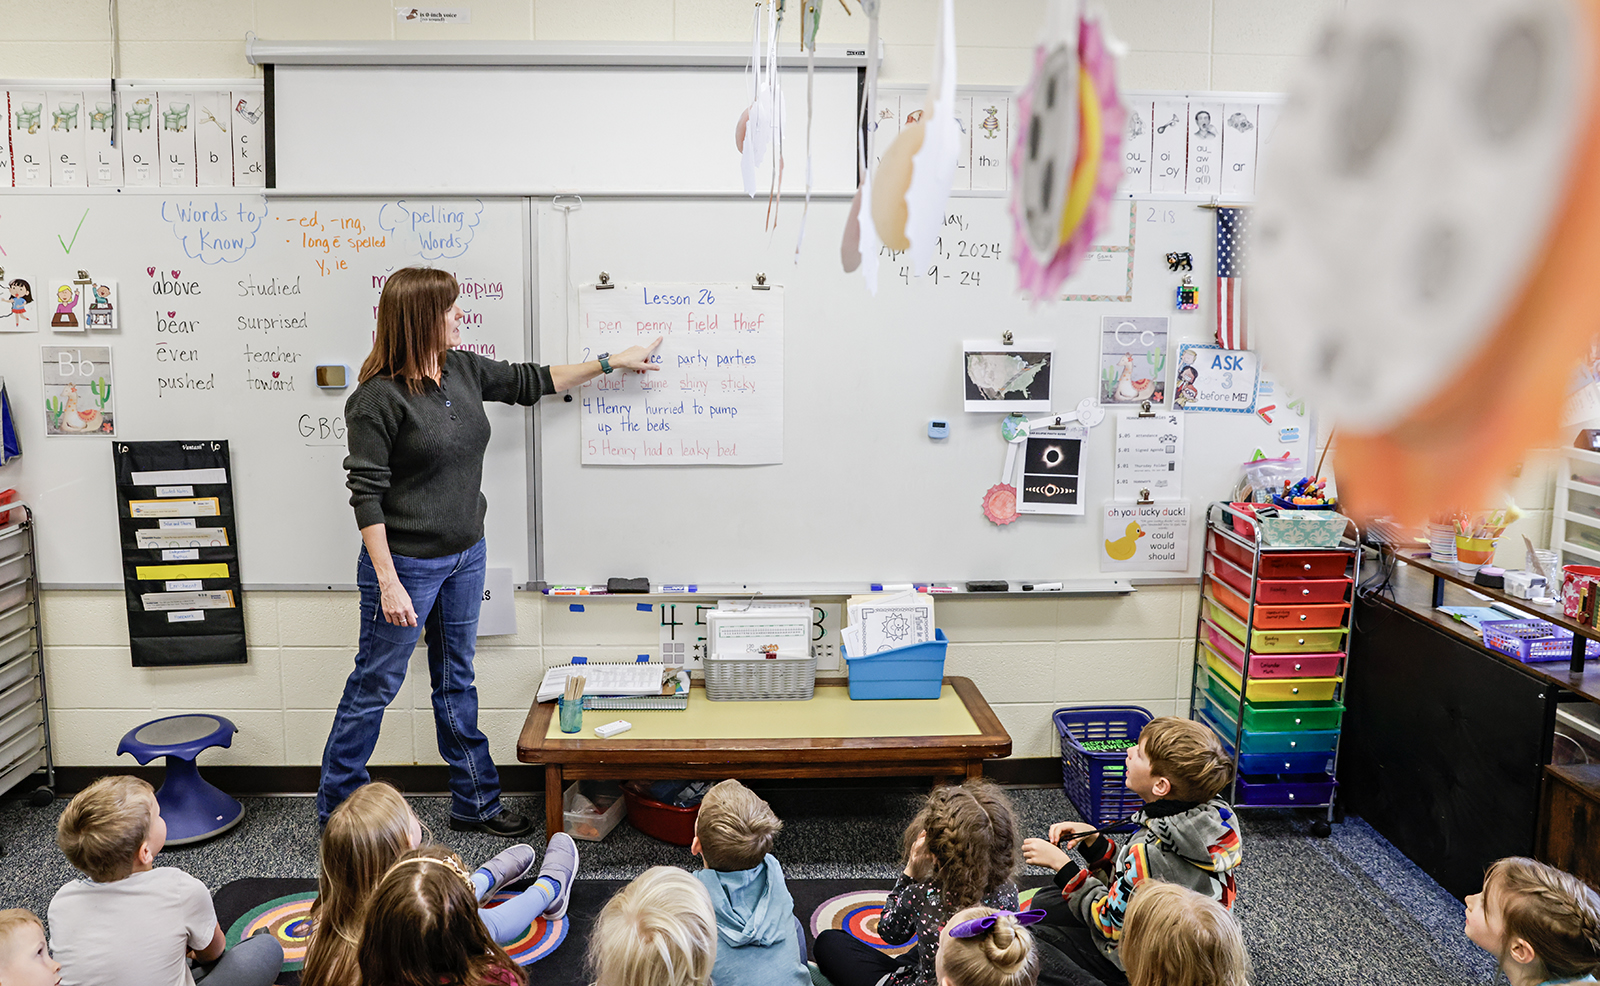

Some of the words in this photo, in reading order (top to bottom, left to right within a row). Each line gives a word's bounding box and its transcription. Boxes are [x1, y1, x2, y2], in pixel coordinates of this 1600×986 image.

[210, 151, 218, 163] b
[1160, 151, 1171, 161] oi
[1232, 163, 1246, 172] ar
[176, 202, 228, 223] Words
[237, 201, 257, 223] to
[393, 200, 465, 233] Spelling
[200, 231, 245, 250] Know
[302, 233, 329, 254] long
[347, 235, 386, 251] spelled
[419, 231, 463, 250] Words
[958, 240, 1001, 260] 2024
[335, 258, 349, 270] ie
[153, 271, 201, 296] above
[644, 287, 690, 305] Lesson
[698, 288, 715, 305] 26
[156, 311, 200, 334] bear
[237, 312, 308, 333] surprised
[599, 319, 622, 333] pen
[636, 320, 673, 336] penny
[687, 311, 719, 331] field
[733, 313, 765, 331] thief
[1115, 321, 1155, 347] Cc
[58, 350, 95, 377] Bb
[244, 343, 302, 365] teacher
[677, 348, 709, 367] party
[716, 348, 757, 368] parties
[1211, 354, 1244, 372] ASK
[158, 373, 215, 394] pushed
[246, 371, 295, 392] toward
[597, 372, 628, 389] chief
[640, 373, 669, 389] shine
[680, 373, 709, 394] shiny
[721, 374, 756, 394] sticky
[1221, 372, 1234, 389] 3
[1200, 390, 1230, 402] before
[1232, 392, 1248, 403] ME!
[583, 397, 592, 414] 4
[596, 396, 632, 419] Henry
[645, 398, 684, 415] hurried
[692, 399, 704, 415] to
[709, 405, 738, 419] pump
[298, 413, 346, 440] GBG
[597, 423, 612, 436] up
[620, 415, 641, 432] the
[588, 439, 597, 455] 5
[602, 439, 637, 460] Henry
[643, 440, 663, 456] had
[667, 447, 674, 456] a
[680, 439, 710, 459] leaky
[1108, 508, 1119, 517] oh
[1121, 509, 1136, 518] you
[1138, 508, 1160, 518] lucky
[1162, 507, 1186, 516] duck!
[1151, 531, 1174, 539] could
[1148, 552, 1175, 560] should
[1150, 542, 1175, 550] would
[662, 605, 683, 640] 4
